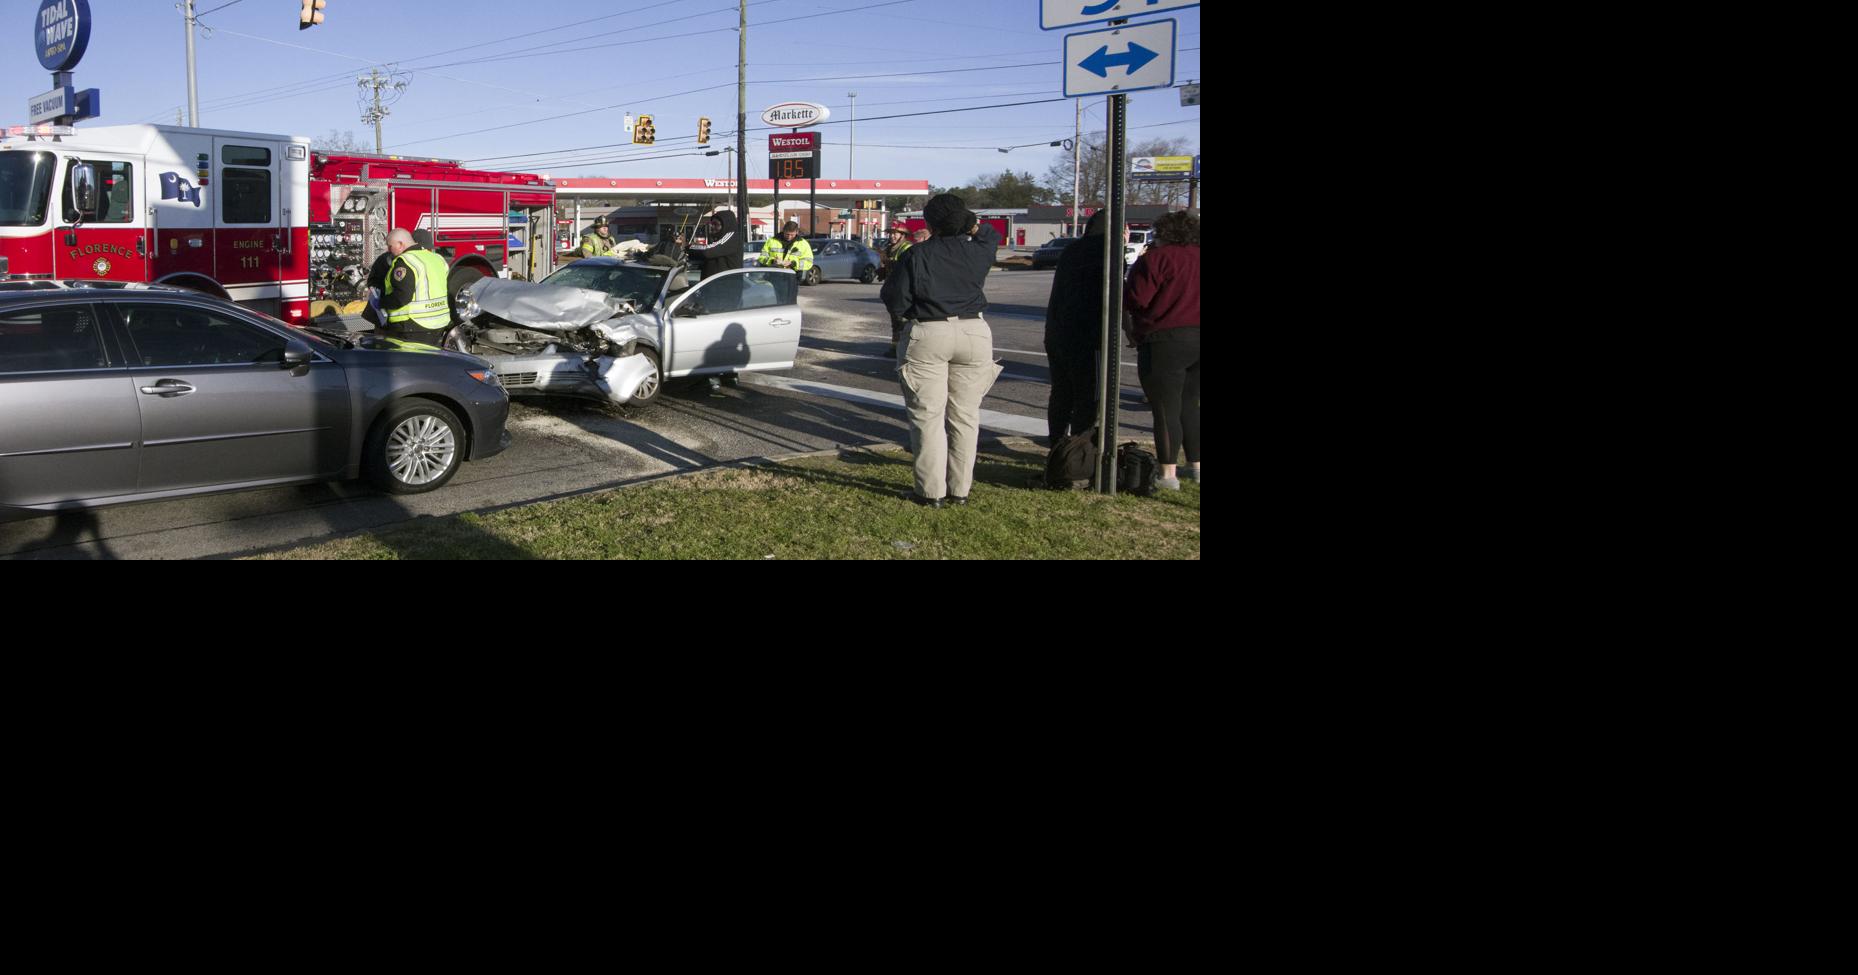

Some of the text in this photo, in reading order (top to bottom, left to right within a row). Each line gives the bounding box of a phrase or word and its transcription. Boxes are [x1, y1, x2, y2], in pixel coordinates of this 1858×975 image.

[41, 0, 68, 26] TIDAL
[46, 17, 73, 45] WAVE
[31, 96, 63, 116] FREE VACUUM
[769, 109, 814, 121] Markette
[772, 137, 810, 147] WESTOIL
[703, 178, 738, 188] WESTOI
[69, 243, 133, 260] FLORENCE
[233, 240, 264, 249] ENGINE
[240, 255, 259, 269] 111
